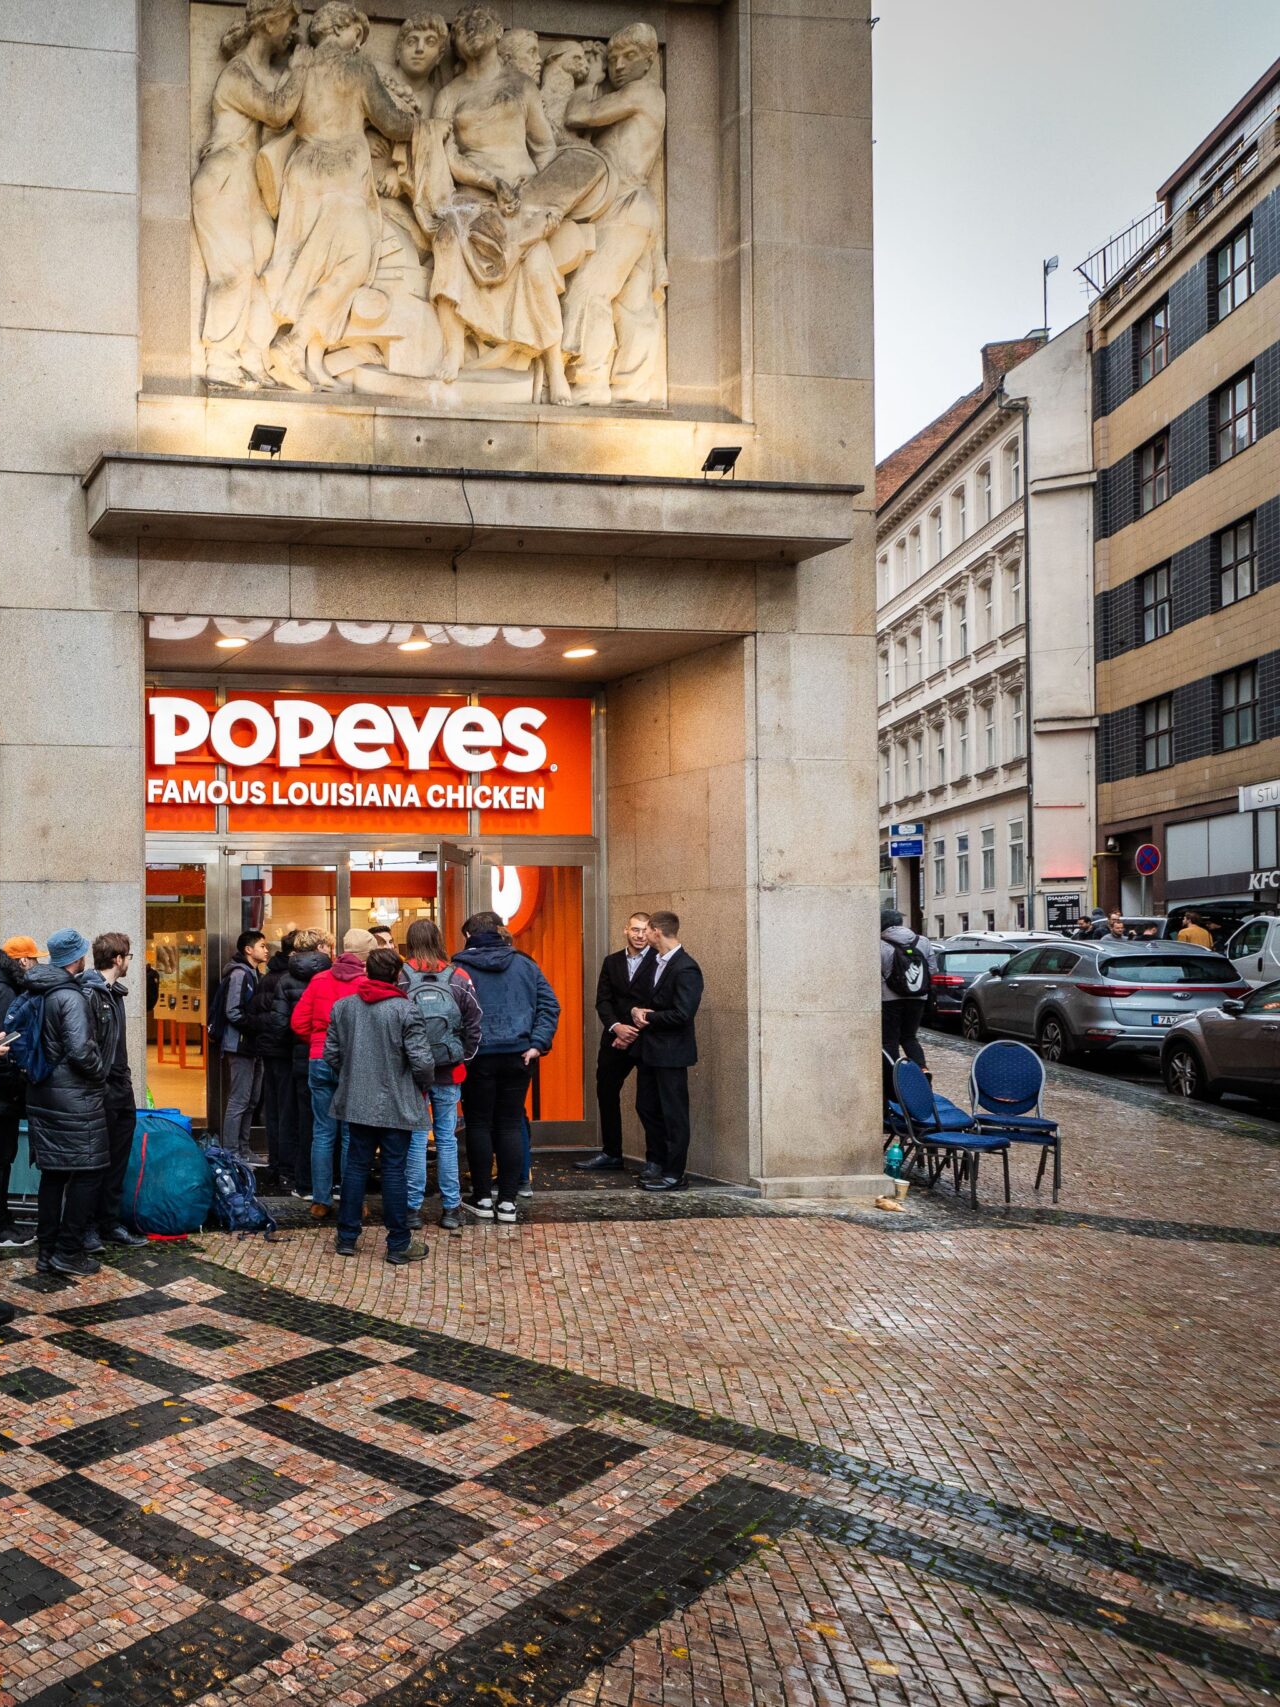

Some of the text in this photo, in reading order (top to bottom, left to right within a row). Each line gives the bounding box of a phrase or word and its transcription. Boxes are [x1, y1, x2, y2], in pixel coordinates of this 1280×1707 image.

[147, 778, 545, 810] FAMOUS LOUISIANA CHICKEN
[1248, 871, 1280, 891] KFC
